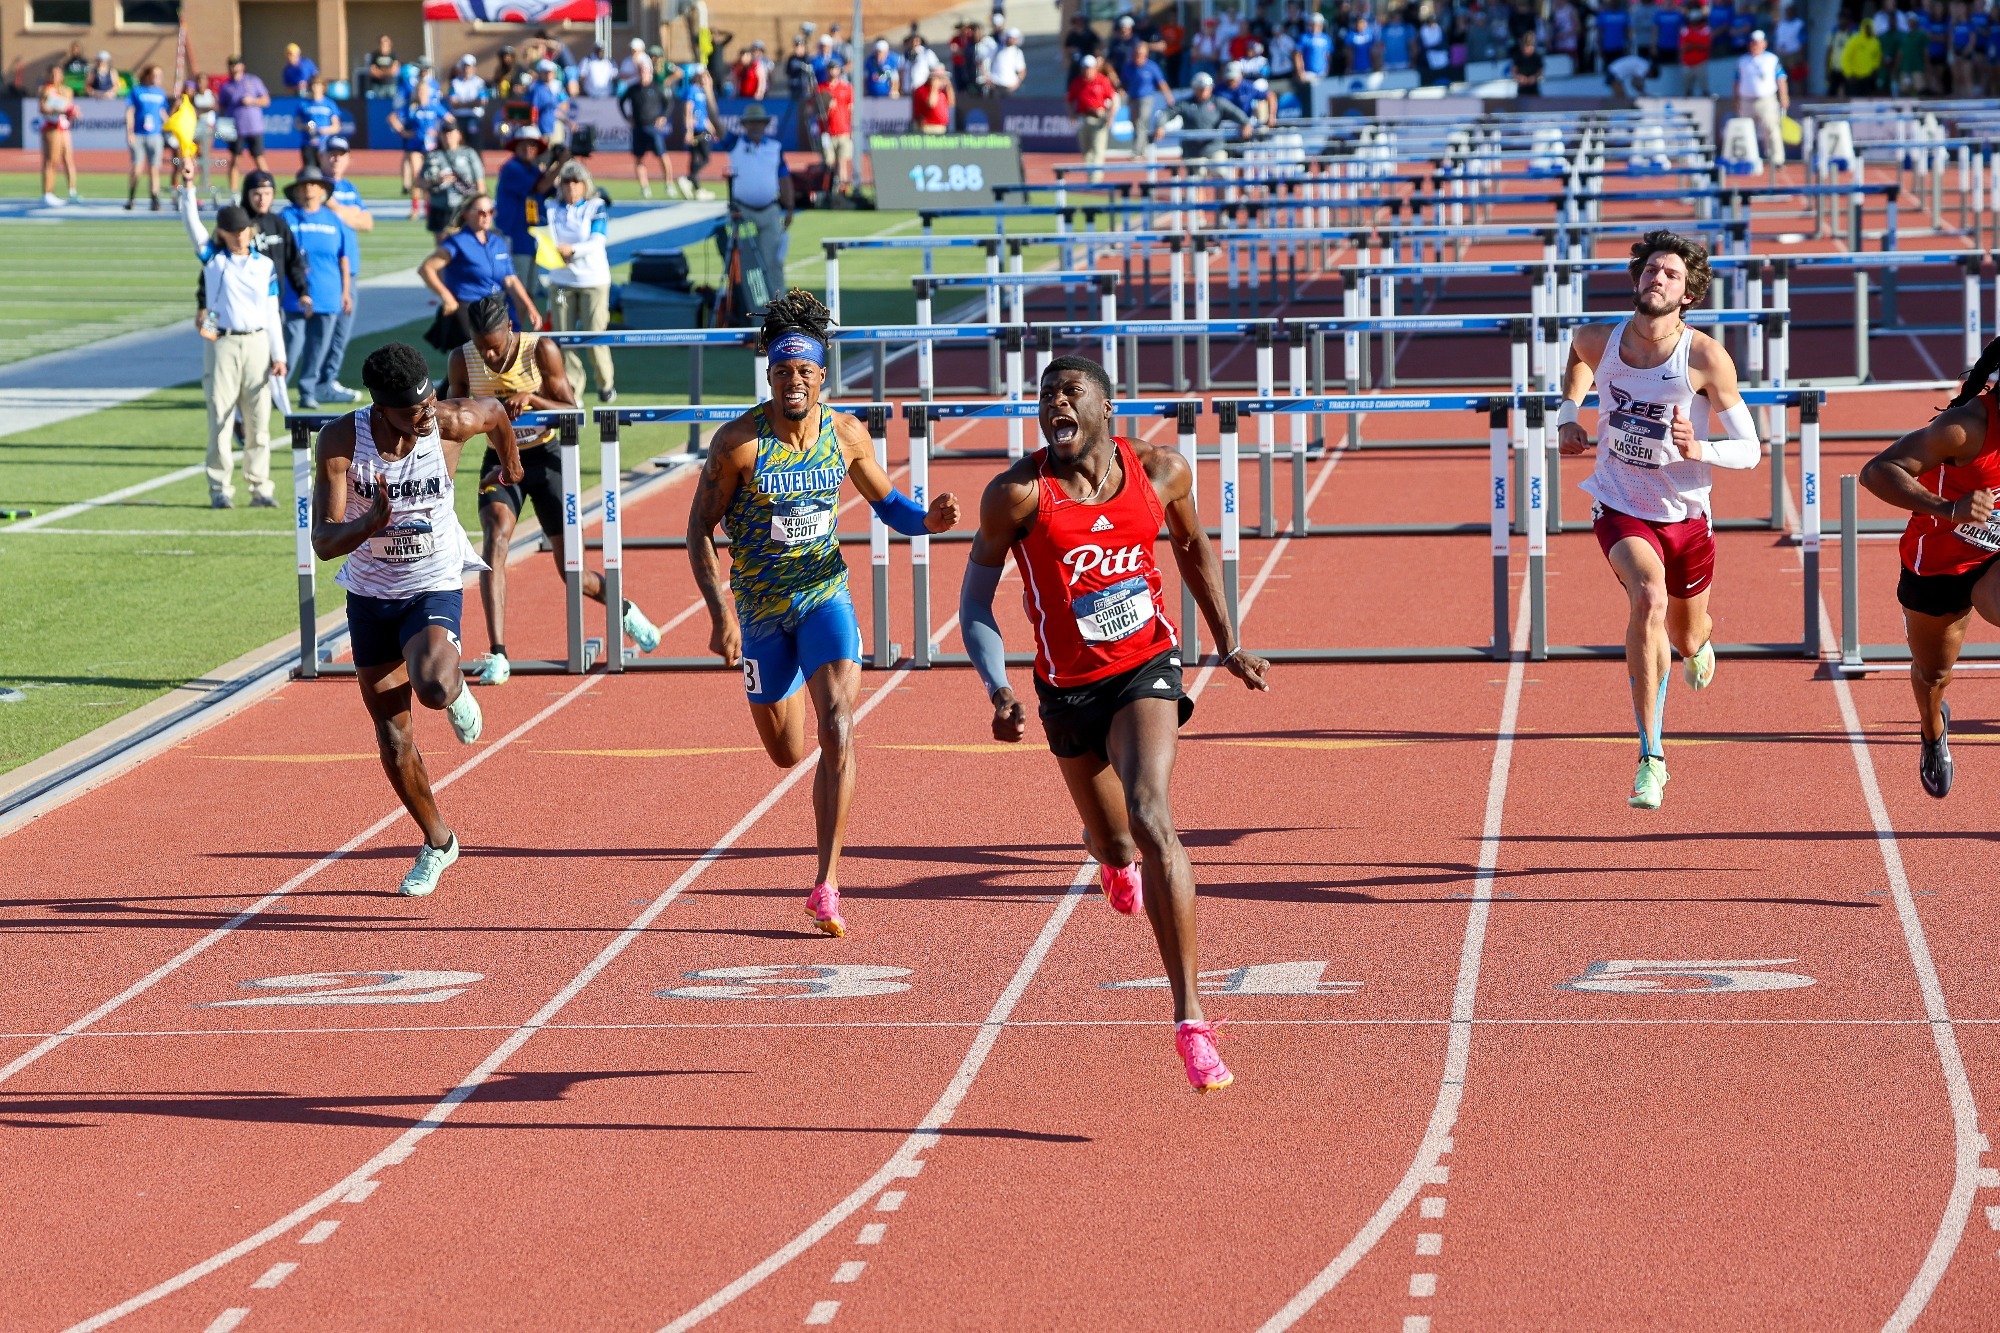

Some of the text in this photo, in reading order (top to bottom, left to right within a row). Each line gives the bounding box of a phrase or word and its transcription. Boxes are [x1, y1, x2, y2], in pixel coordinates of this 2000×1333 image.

[908, 163, 984, 192] 12.88
[709, 411, 730, 419] TRACK
[1018, 406, 1039, 414] TRACK
[1329, 401, 1350, 409] TRACK
[1375, 400, 1430, 408] CHAMPIONSHIPS
[1617, 398, 1667, 420] LEE
[515, 428, 537, 439] ELDS
[1625, 433, 1643, 446] CALE
[1614, 439, 1653, 460] KASSEN
[758, 467, 845, 494] JAVELINAS
[1495, 477, 1505, 509] NCAA
[1532, 477, 1541, 509] NCAA
[1805, 472, 1816, 505] NCAA
[566, 493, 576, 525] NCAA
[605, 490, 616, 522] NCAA
[914, 485, 924, 508] NC
[1224, 481, 1234, 513] NCAA
[297, 496, 308, 528] NCAA
[392, 536, 412, 545] TROY
[786, 524, 818, 539] SCOTT
[384, 544, 422, 556] WHYTE
[1062, 543, 1144, 586] Pitt
[1095, 599, 1136, 624] CORDELL
[1099, 610, 1139, 637] TINCH
[745, 660, 756, 692] 3
[203, 969, 486, 1008] 2
[653, 964, 915, 1000] 3
[1553, 957, 1818, 995] 5
